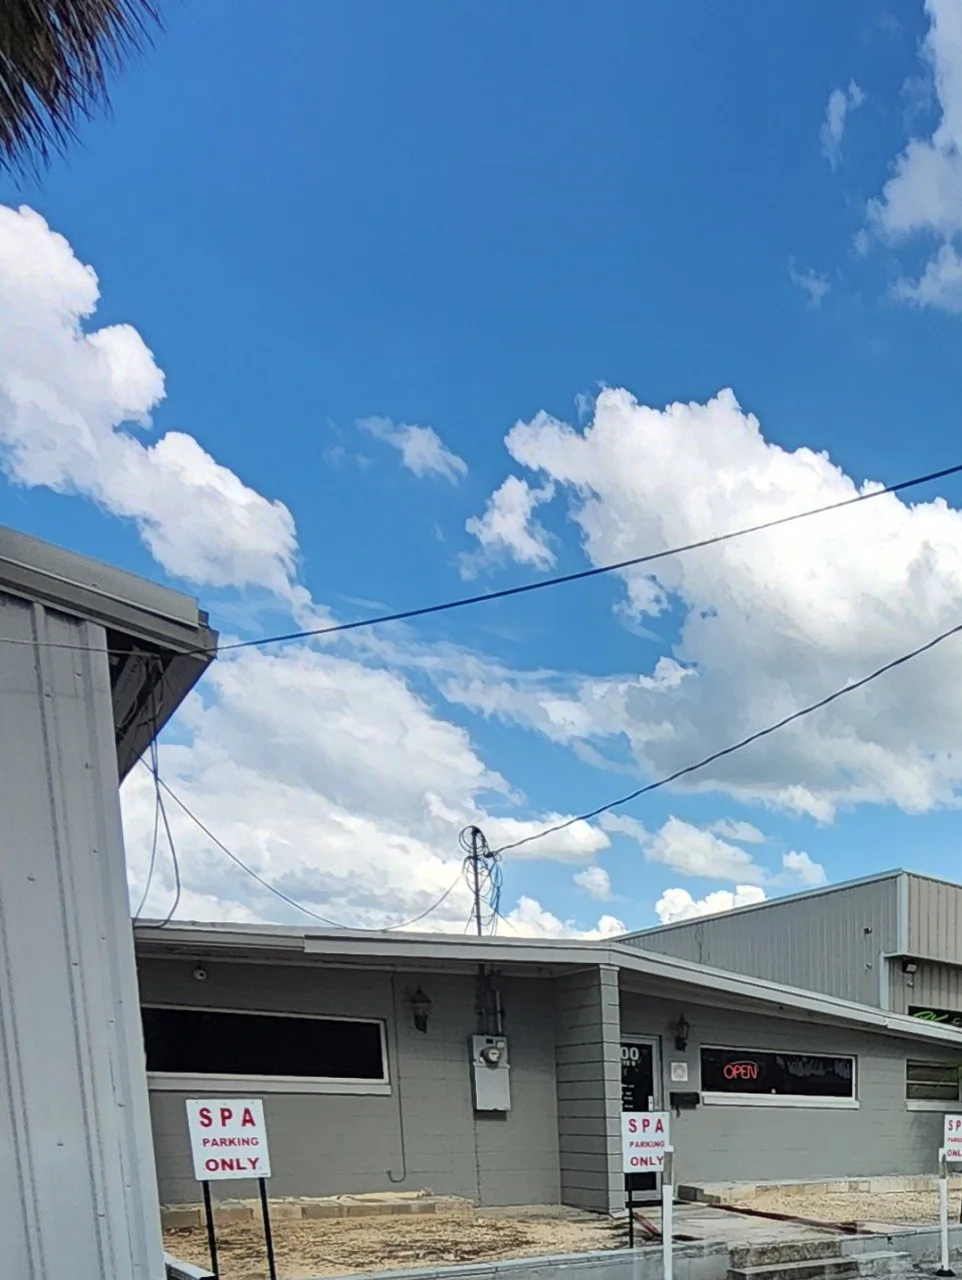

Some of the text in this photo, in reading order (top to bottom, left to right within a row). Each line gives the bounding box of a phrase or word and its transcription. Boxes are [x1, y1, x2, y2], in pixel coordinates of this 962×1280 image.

[723, 1063, 758, 1079] OPEN
[199, 1107, 256, 1127] SPA
[628, 1118, 664, 1133] SPA
[202, 1137, 259, 1147] PARKING
[629, 1140, 665, 1148] PARKING
[205, 1157, 259, 1171] ONLY
[630, 1155, 664, 1166] ONLY
